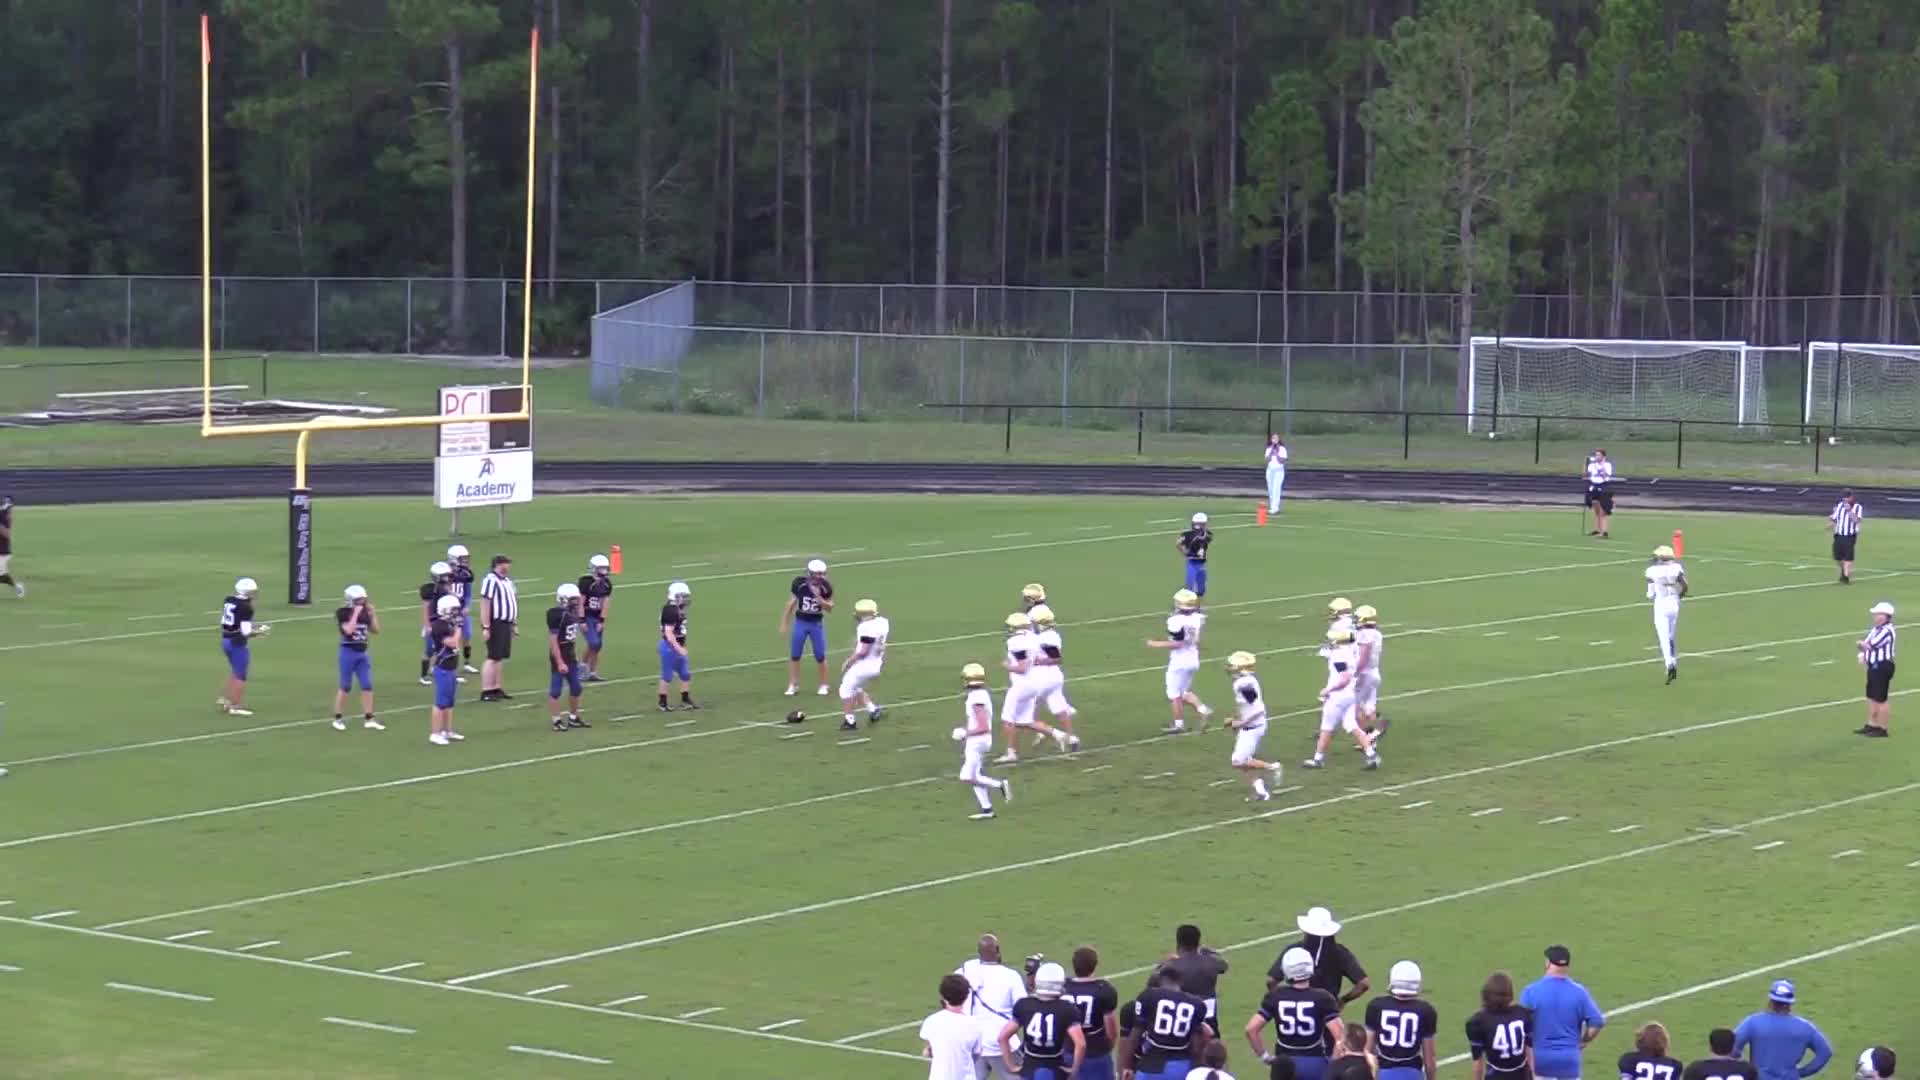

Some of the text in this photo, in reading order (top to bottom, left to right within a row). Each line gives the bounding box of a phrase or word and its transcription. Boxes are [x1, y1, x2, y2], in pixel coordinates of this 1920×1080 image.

[456, 481, 516, 498] Academy
[1026, 1012, 1054, 1047] 41
[1061, 995, 1094, 1028] 7
[1154, 999, 1195, 1037] 68
[1278, 1000, 1316, 1036] 55
[1379, 1009, 1419, 1048] 50
[1492, 1020, 1525, 1058] 40
